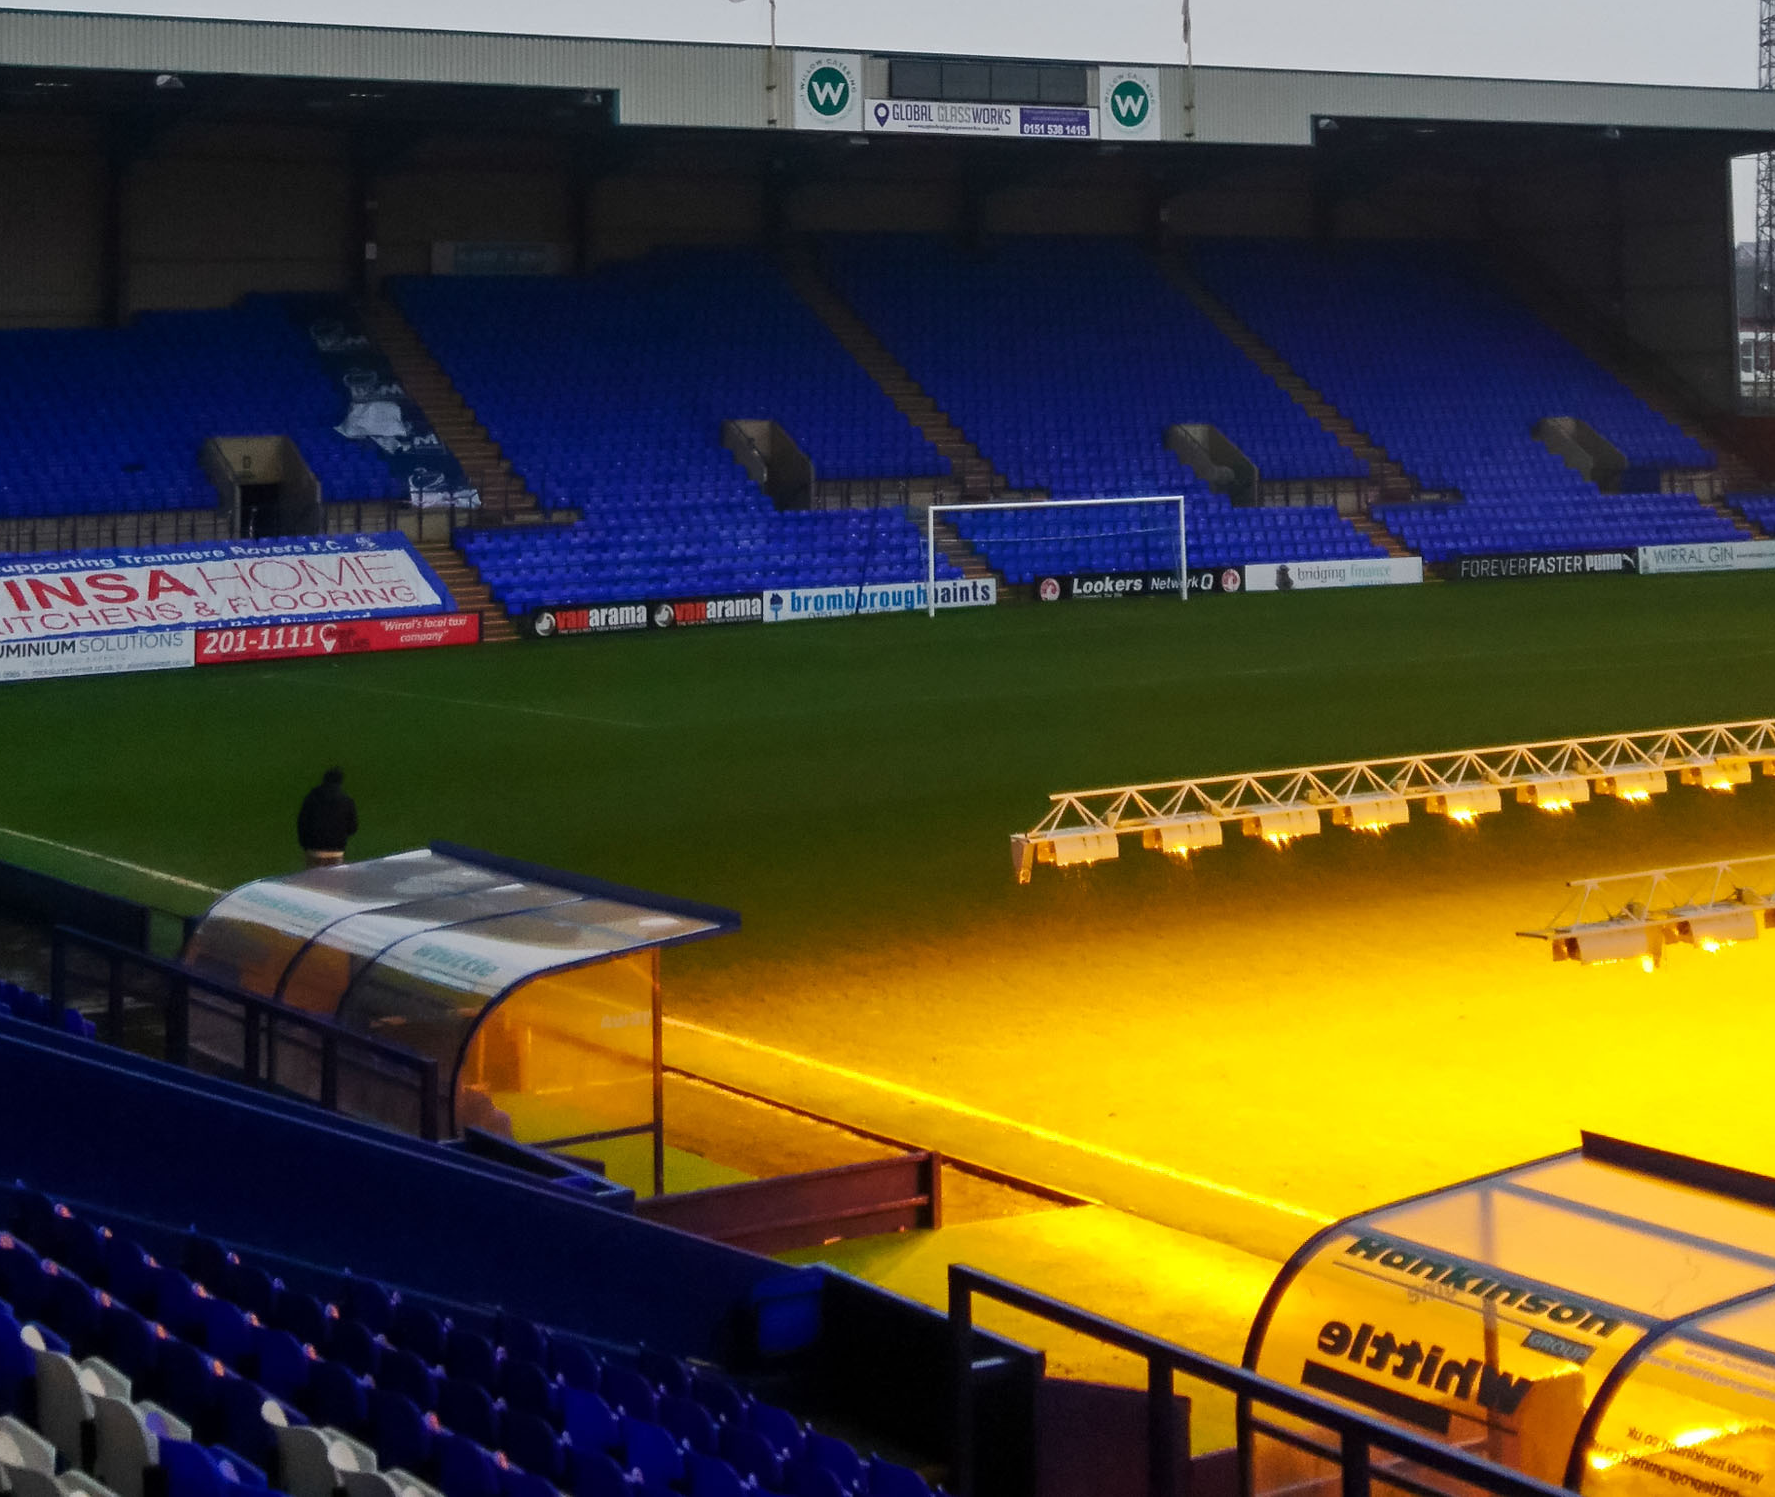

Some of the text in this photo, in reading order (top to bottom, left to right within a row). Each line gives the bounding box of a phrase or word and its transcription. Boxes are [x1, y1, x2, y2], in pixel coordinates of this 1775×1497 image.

[811, 81, 846, 107] W
[1114, 94, 1145, 118] W
[892, 103, 933, 122] GLOBAL
[1023, 123, 1045, 135] 0151
[1065, 124, 1087, 136] 1415
[124, 549, 226, 568] Tranmere
[236, 543, 306, 557] Rovers
[1461, 553, 1623, 578] FOREVER FASTER PUMA
[1654, 546, 1734, 565] WIRRAL GIN
[197, 554, 407, 598] HOME
[1072, 573, 1214, 594] Lookers Netwrk Q
[1297, 567, 1346, 582] bridging
[194, 601, 221, 619] &
[227, 585, 418, 615] FLOORING
[675, 597, 763, 620] vanarama
[791, 584, 927, 613] bromborough
[424, 617, 447, 629] local
[448, 616, 468, 628] taxi
[555, 605, 648, 629] vanarama
[79, 633, 185, 653] SOLUTIONS
[203, 624, 317, 655] 201-1111
[400, 630, 450, 645] company"
[1344, 1235, 1623, 1338] Hankinson
